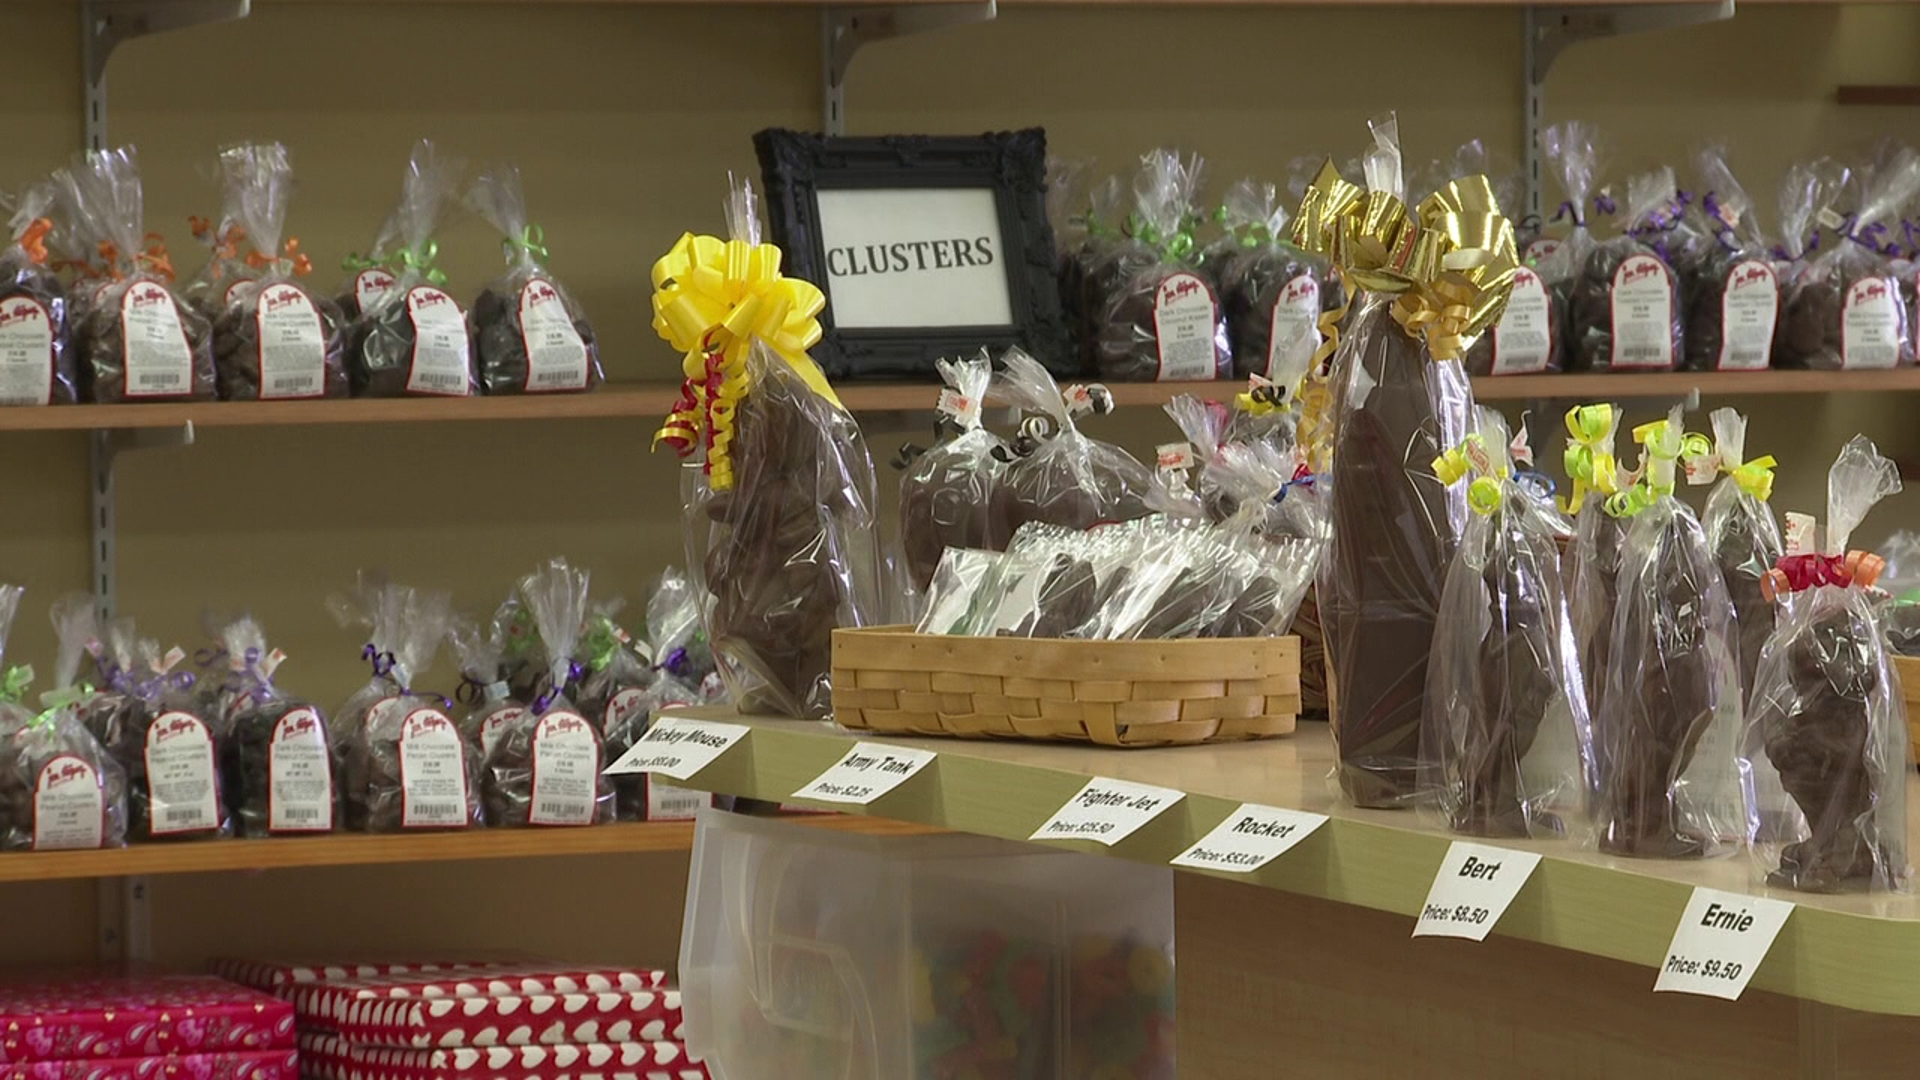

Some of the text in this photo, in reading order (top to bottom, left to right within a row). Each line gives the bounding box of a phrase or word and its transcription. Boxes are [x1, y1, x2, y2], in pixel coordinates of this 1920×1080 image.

[827, 236, 994, 277] CLUSTERS
[644, 728, 728, 748] Mickey Mouse
[840, 753, 914, 774] Army Tank
[813, 782, 844, 795] Price:
[1075, 788, 1162, 811] Fighter Jet
[1046, 821, 1079, 833] Price:
[1232, 816, 1297, 838] Rocket
[1187, 848, 1225, 861] Price:
[1458, 856, 1502, 880] Bert
[1421, 903, 1489, 924] Price: $8.50
[1700, 903, 1755, 932] Ernie
[1665, 955, 1743, 980] Price: $9.50
